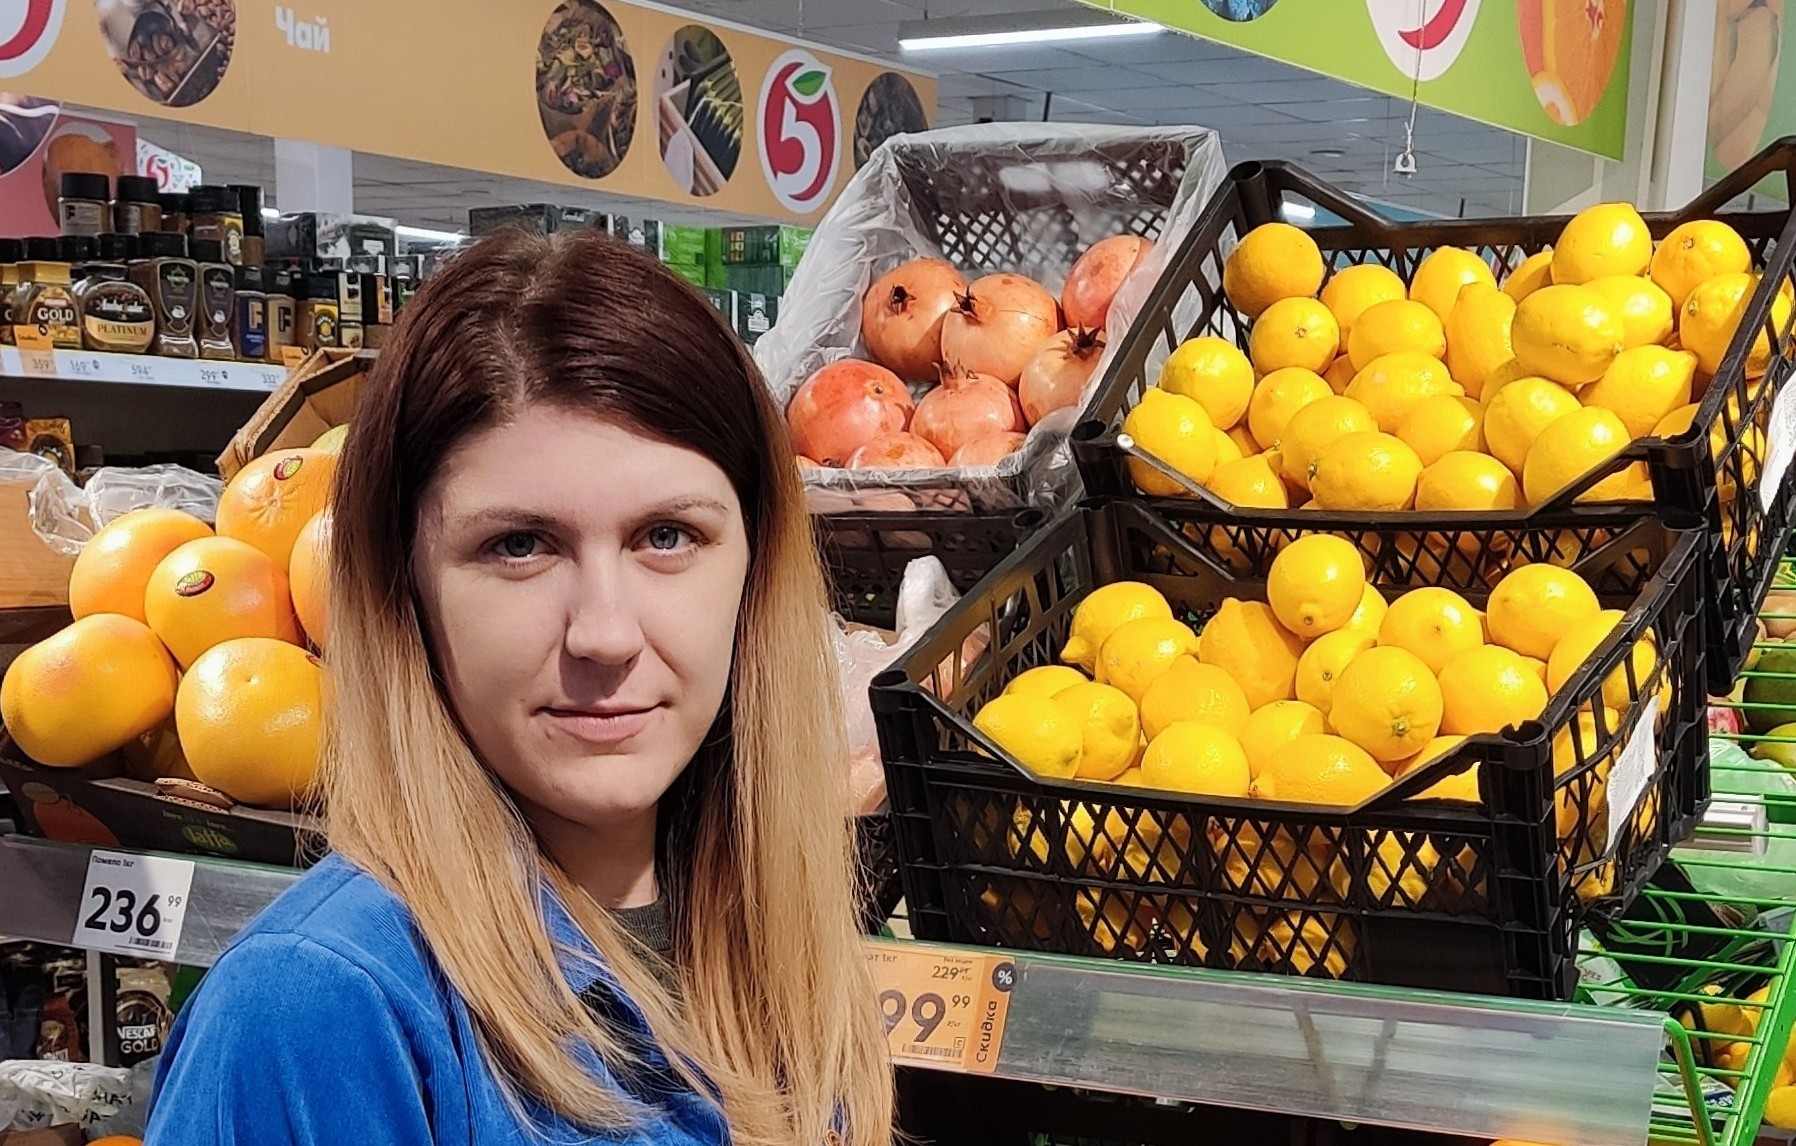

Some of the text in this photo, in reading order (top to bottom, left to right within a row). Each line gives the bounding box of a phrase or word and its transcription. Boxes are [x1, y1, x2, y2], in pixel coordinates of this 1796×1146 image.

[275, 6, 331, 53] Чай
[37, 307, 74, 321] GOLD
[97, 323, 148, 336] PLATINUM
[84, 886, 182, 937] 236 99
[931, 965, 959, 980] 229
[997, 969, 1013, 985] %
[952, 994, 971, 1009] 99
[976, 1001, 998, 1063] Скидка
[120, 1039, 158, 1053] GOLD
